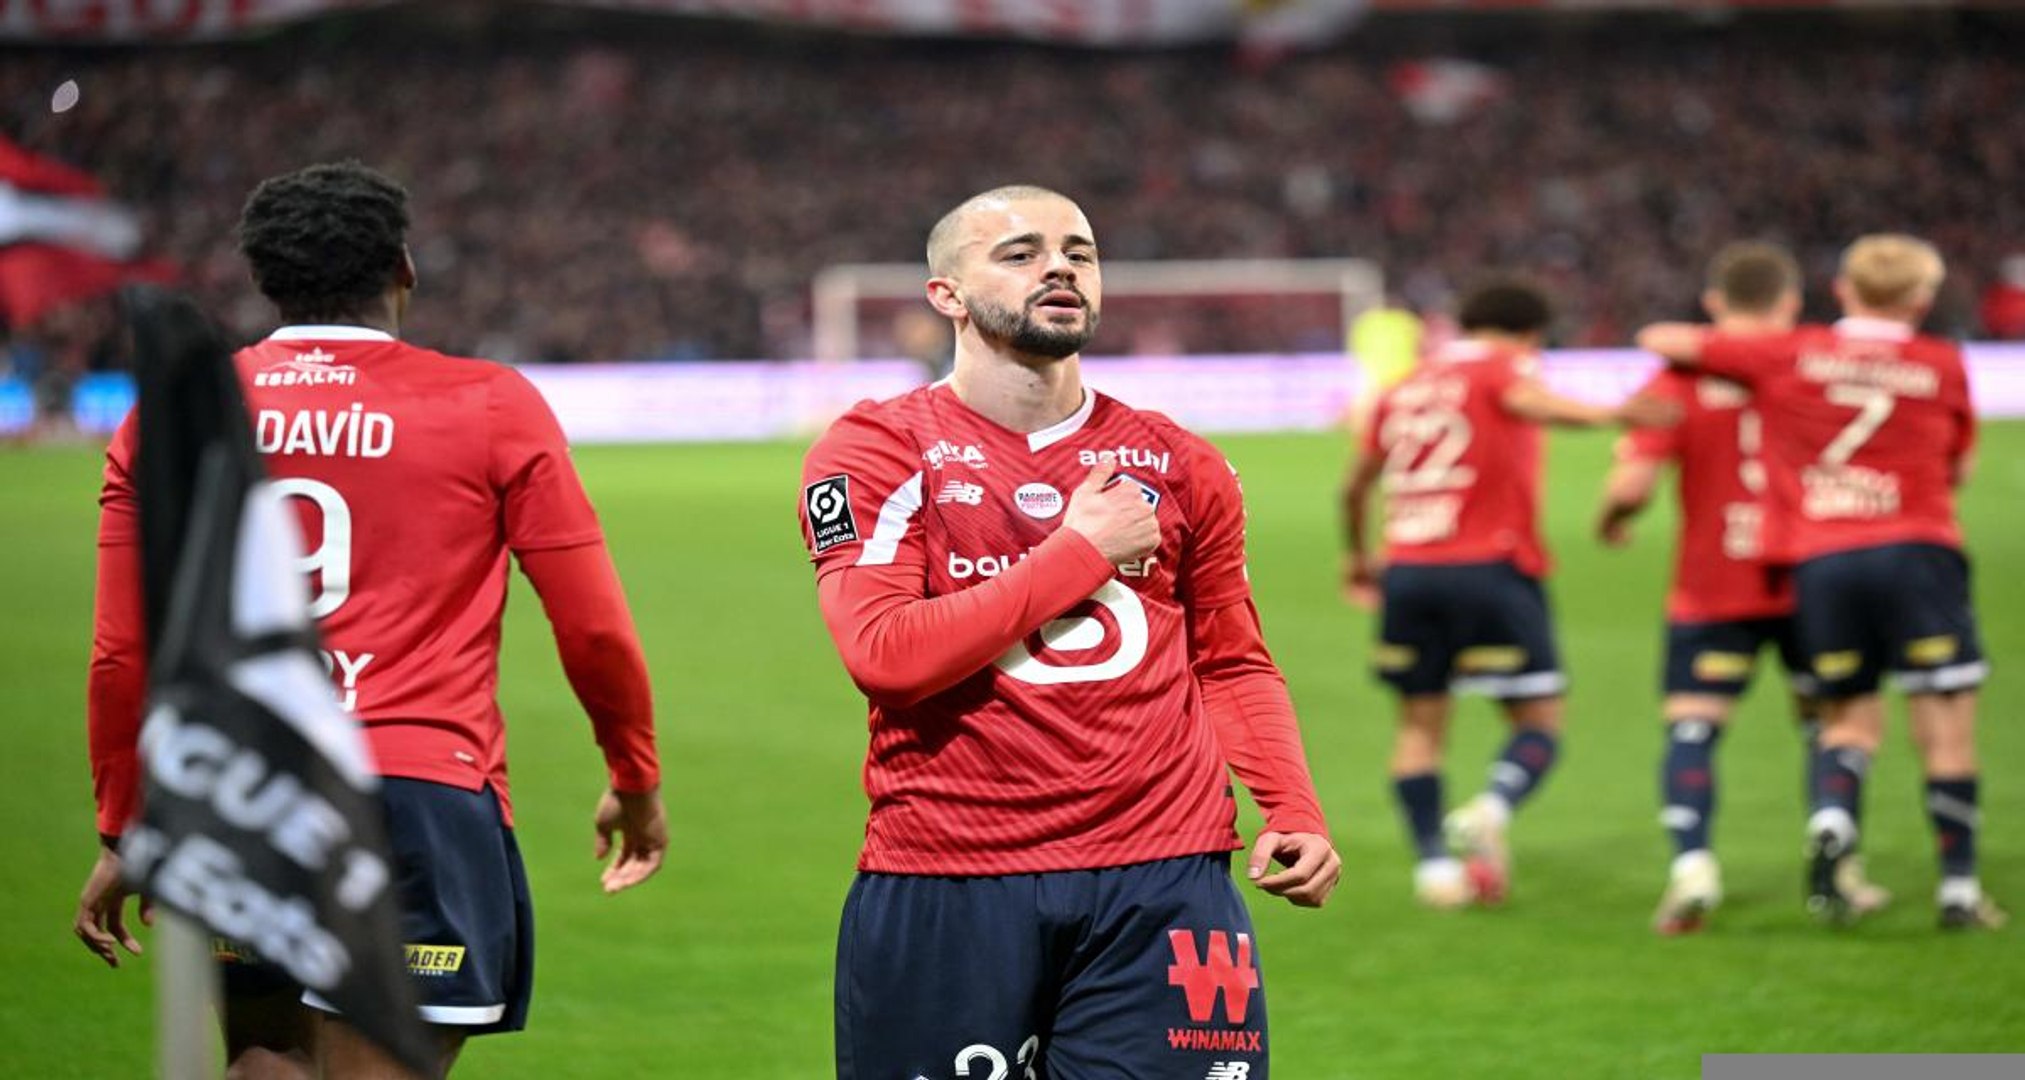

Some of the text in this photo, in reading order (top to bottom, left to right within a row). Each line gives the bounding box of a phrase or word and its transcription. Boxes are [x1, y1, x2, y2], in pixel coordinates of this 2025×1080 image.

[1379, 410, 1477, 493] 22
[1824, 382, 1897, 467] 7
[264, 476, 352, 622] 9
[407, 950, 458, 967] ADER
[1167, 1027, 1262, 1052] WINAMAX
